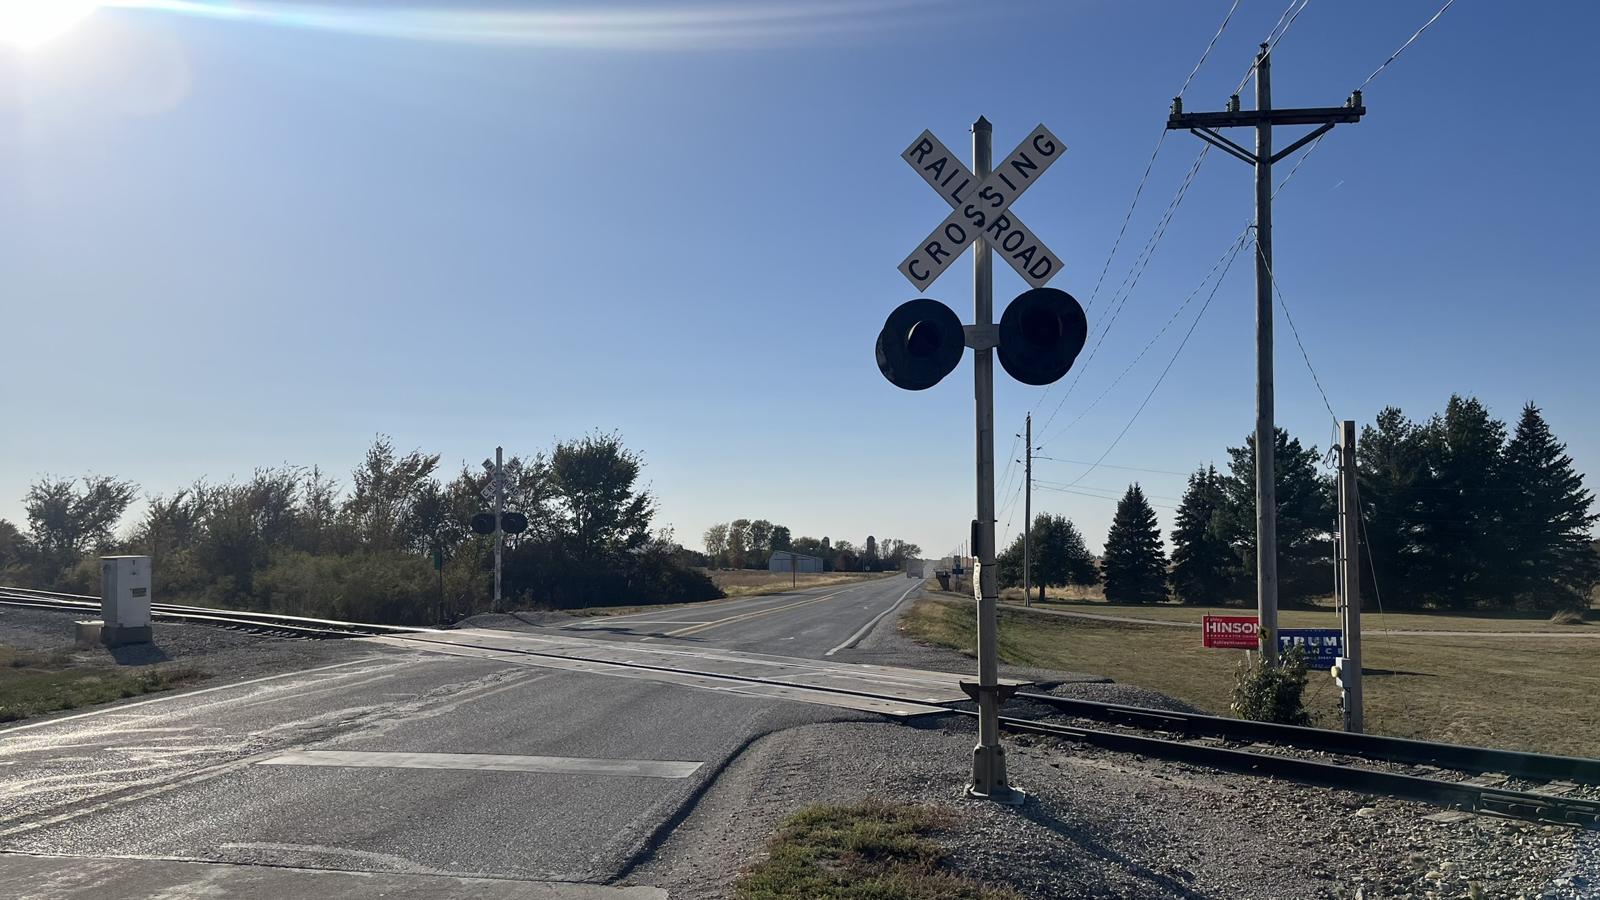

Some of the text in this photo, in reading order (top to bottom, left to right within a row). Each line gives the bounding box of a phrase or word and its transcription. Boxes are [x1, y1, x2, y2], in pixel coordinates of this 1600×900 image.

[908, 134, 1056, 281] CROSSING
[482, 459, 519, 497] CROING
[1280, 636, 1343, 647] TRUM
